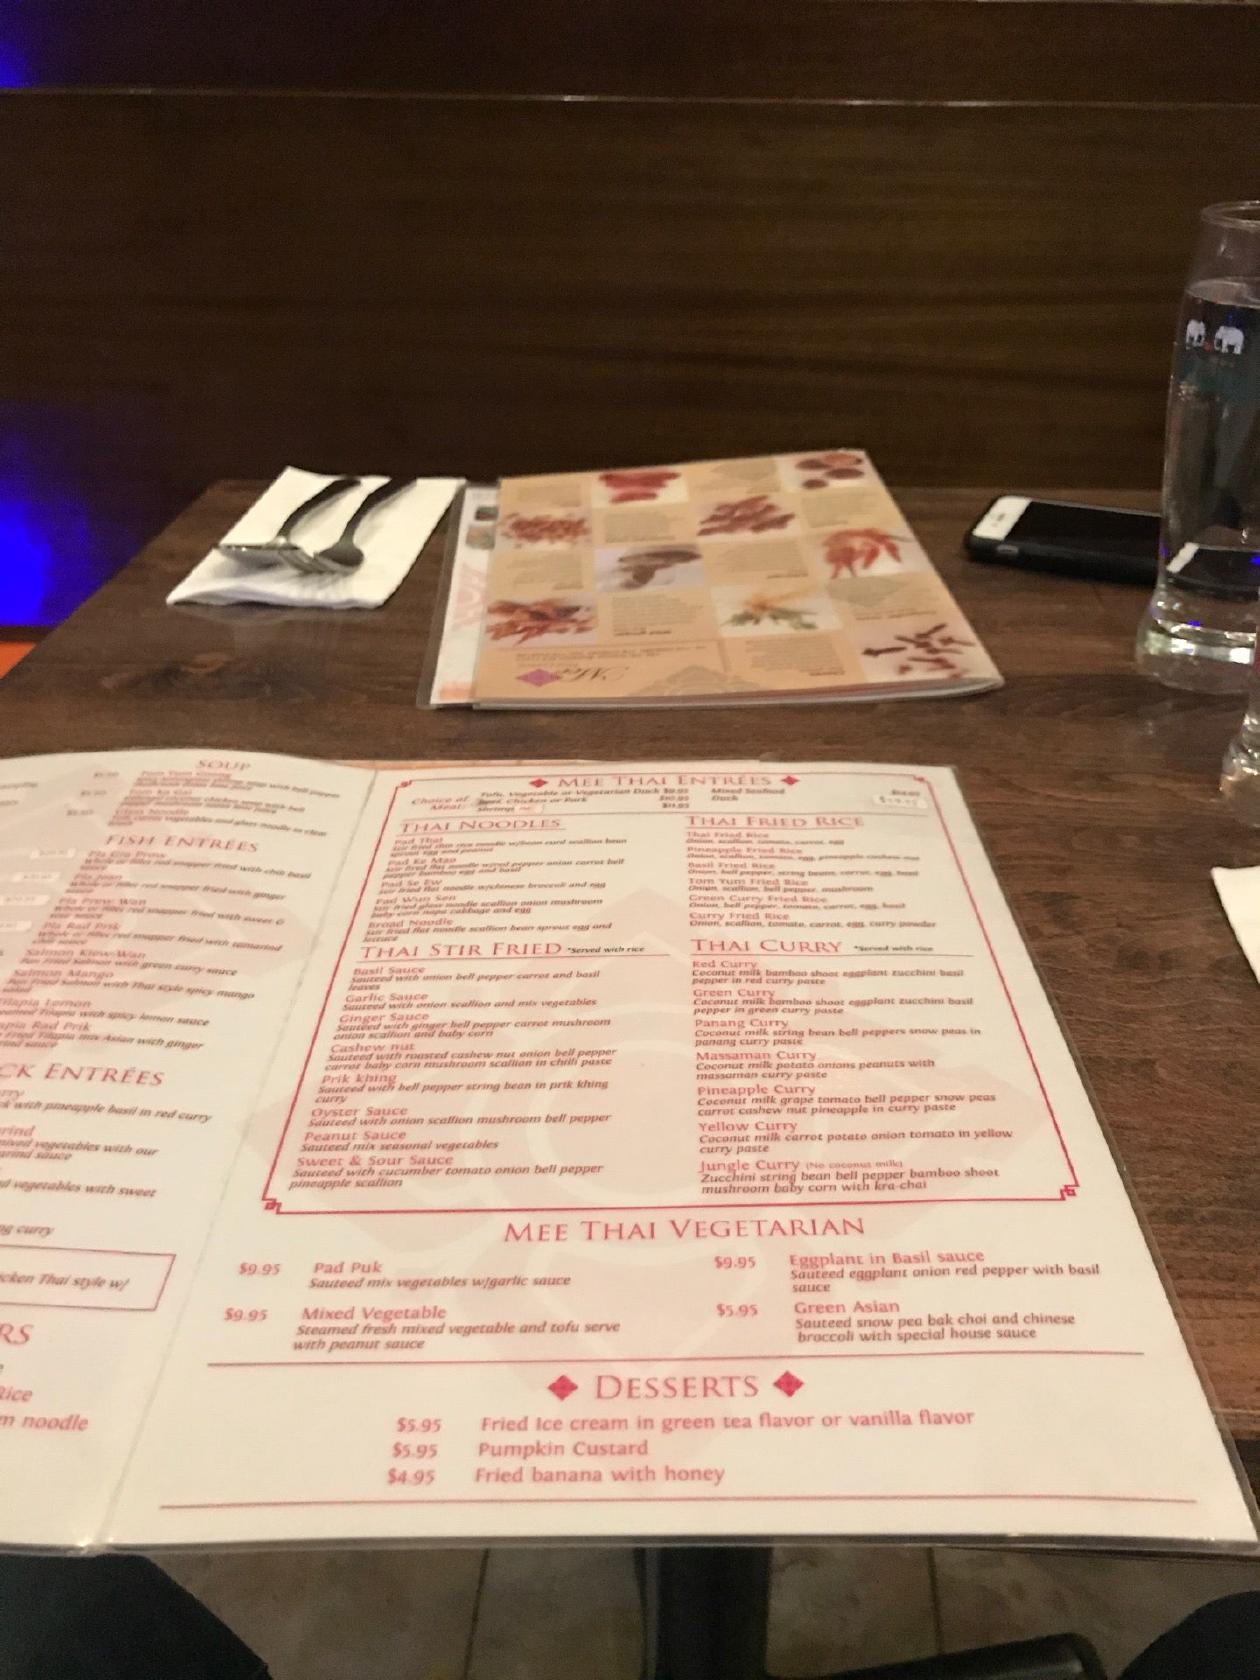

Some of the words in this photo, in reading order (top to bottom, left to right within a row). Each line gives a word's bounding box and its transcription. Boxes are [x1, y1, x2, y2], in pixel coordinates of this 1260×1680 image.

[196, 760, 250, 771] SOUP
[559, 778, 605, 787] MEE
[612, 775, 666, 786] THAI
[679, 775, 771, 785] ENTRÉES
[402, 822, 451, 832] THAI
[460, 819, 560, 830] NOODLES
[687, 816, 736, 826] THAI
[746, 817, 807, 827] FRIED
[816, 817, 864, 826] RICE
[106, 835, 154, 846] FISH
[165, 835, 258, 852] ENTRÉES
[730, 895, 766, 903] Curry
[690, 913, 724, 921] Curry
[360, 946, 419, 958] THAI
[430, 944, 482, 957] STIR
[493, 942, 561, 955] FRIED
[690, 939, 750, 951] THAI
[760, 939, 842, 952] CURRY
[353, 967, 384, 975] Basil
[388, 966, 425, 974] Sauce
[693, 960, 716, 968] Red
[721, 960, 757, 969] Curry
[345, 993, 385, 1002] Garlic
[389, 992, 428, 1001] Sauce
[693, 989, 732, 997] Green
[737, 989, 775, 998] Curry
[339, 1014, 386, 1024] Ginger
[389, 1012, 429, 1021] Sauce
[695, 1019, 745, 1029] Panang
[750, 1019, 788, 1029] Curry
[330, 1043, 386, 1053] Cashew
[390, 1042, 415, 1050] nut
[696, 1051, 770, 1060] Massaman
[776, 1051, 816, 1061] Curry
[45, 1063, 165, 1086] ENTRÉES
[322, 1075, 351, 1084] Prik
[356, 1074, 397, 1085] khing
[697, 1085, 768, 1096] Pineapple
[773, 1085, 816, 1096] Curry
[311, 1108, 361, 1119] Oyster
[366, 1106, 408, 1116] Sauce
[699, 1121, 749, 1131] Yellow
[754, 1121, 798, 1132] Curry
[305, 1131, 358, 1142] Peanut
[363, 1130, 406, 1140] Sauce
[297, 1157, 344, 1167] Sweet
[349, 1156, 361, 1165] &
[368, 1156, 402, 1166] Sour
[409, 1154, 454, 1164] Sauce
[700, 1160, 750, 1173] Jungle
[755, 1159, 800, 1172] Curry
[828, 1161, 871, 1169] coconut
[875, 1159, 903, 1169] milk)
[701, 1172, 756, 1183] Zucchini
[760, 1173, 796, 1185] string
[801, 1172, 831, 1181] bean
[836, 1171, 858, 1180] bell
[862, 1171, 903, 1182] pepper
[909, 1169, 960, 1178] bamboo
[965, 1168, 998, 1177] shoot
[702, 1183, 769, 1195] mushroom
[774, 1182, 803, 1195] baby
[808, 1183, 836, 1191] corn
[842, 1181, 870, 1191] with
[505, 1222, 567, 1242] MEE
[581, 1221, 656, 1240] THAI
[669, 1218, 865, 1239] VEGETARIAN
[715, 1256, 756, 1269] $9.95
[790, 1253, 863, 1268] Eggplant
[870, 1252, 886, 1265] in
[893, 1250, 930, 1264] Basil
[937, 1250, 984, 1263] sauce
[239, 1263, 279, 1275] $9.95
[314, 1262, 343, 1274] Pad
[352, 1261, 383, 1273] Puk
[791, 1268, 845, 1280] Sauteed
[849, 1268, 908, 1281] eggplant
[913, 1267, 950, 1278] onion
[955, 1265, 977, 1276] red
[982, 1266, 1027, 1278] pepper
[1033, 1265, 1064, 1275] with
[1069, 1263, 1100, 1275] basil
[39, 1273, 69, 1284] Thai
[73, 1275, 105, 1290] style
[109, 1278, 129, 1291] w/
[309, 1277, 362, 1288] Sauteed
[367, 1277, 392, 1287] mix
[398, 1275, 467, 1287] vegetables
[472, 1275, 526, 1288] w/garlic
[533, 1275, 570, 1286] sauce
[793, 1283, 830, 1293] sauce
[303, 1307, 354, 1320] Mixed
[362, 1306, 446, 1320] Vegetable
[717, 1304, 758, 1317] $5.95
[794, 1302, 845, 1314] Green
[853, 1301, 899, 1313] Asian
[224, 1308, 267, 1321] $9.95
[796, 1317, 852, 1329] Sauteed
[856, 1316, 893, 1327] snow
[898, 1317, 922, 1329] pea
[927, 1314, 952, 1326] bak
[958, 1313, 987, 1324] choi
[992, 1313, 1018, 1324] and
[1023, 1312, 1075, 1324] chinese
[297, 1324, 357, 1335] Steamed
[362, 1323, 396, 1335] fresh
[401, 1322, 444, 1334] mixed
[449, 1322, 514, 1335] vegetable
[519, 1321, 546, 1333] and
[551, 1321, 580, 1333] tofu
[585, 1322, 620, 1332] serve
[798, 1332, 854, 1342] broccoli
[859, 1330, 891, 1342] with
[897, 1329, 945, 1342] special
[950, 1327, 991, 1339] house
[996, 1328, 1036, 1339] sauce
[294, 1339, 324, 1351] with
[329, 1339, 380, 1352] peanut
[385, 1339, 424, 1350] sauce
[596, 1375, 758, 1400] DESSERTS
[22, 1414, 88, 1431] noodle
[397, 1418, 441, 1431] $5.95
[482, 1416, 528, 1431] Fried
[536, 1416, 564, 1430] Ice
[570, 1418, 628, 1430] cream
[636, 1416, 654, 1430] in
[661, 1415, 715, 1433] green
[723, 1413, 752, 1429] tea
[759, 1411, 812, 1428] flavor
[822, 1413, 840, 1426] or
[849, 1410, 912, 1426] vanilla
[919, 1409, 975, 1426] flavor
[393, 1444, 437, 1457] $5.95
[479, 1442, 564, 1458] Pumpkin
[573, 1441, 648, 1456] Custard
[388, 1469, 434, 1483] $4.95
[475, 1468, 523, 1482] Fried
[532, 1467, 601, 1482] banana
[612, 1467, 656, 1481] with
[665, 1466, 725, 1486] honey
